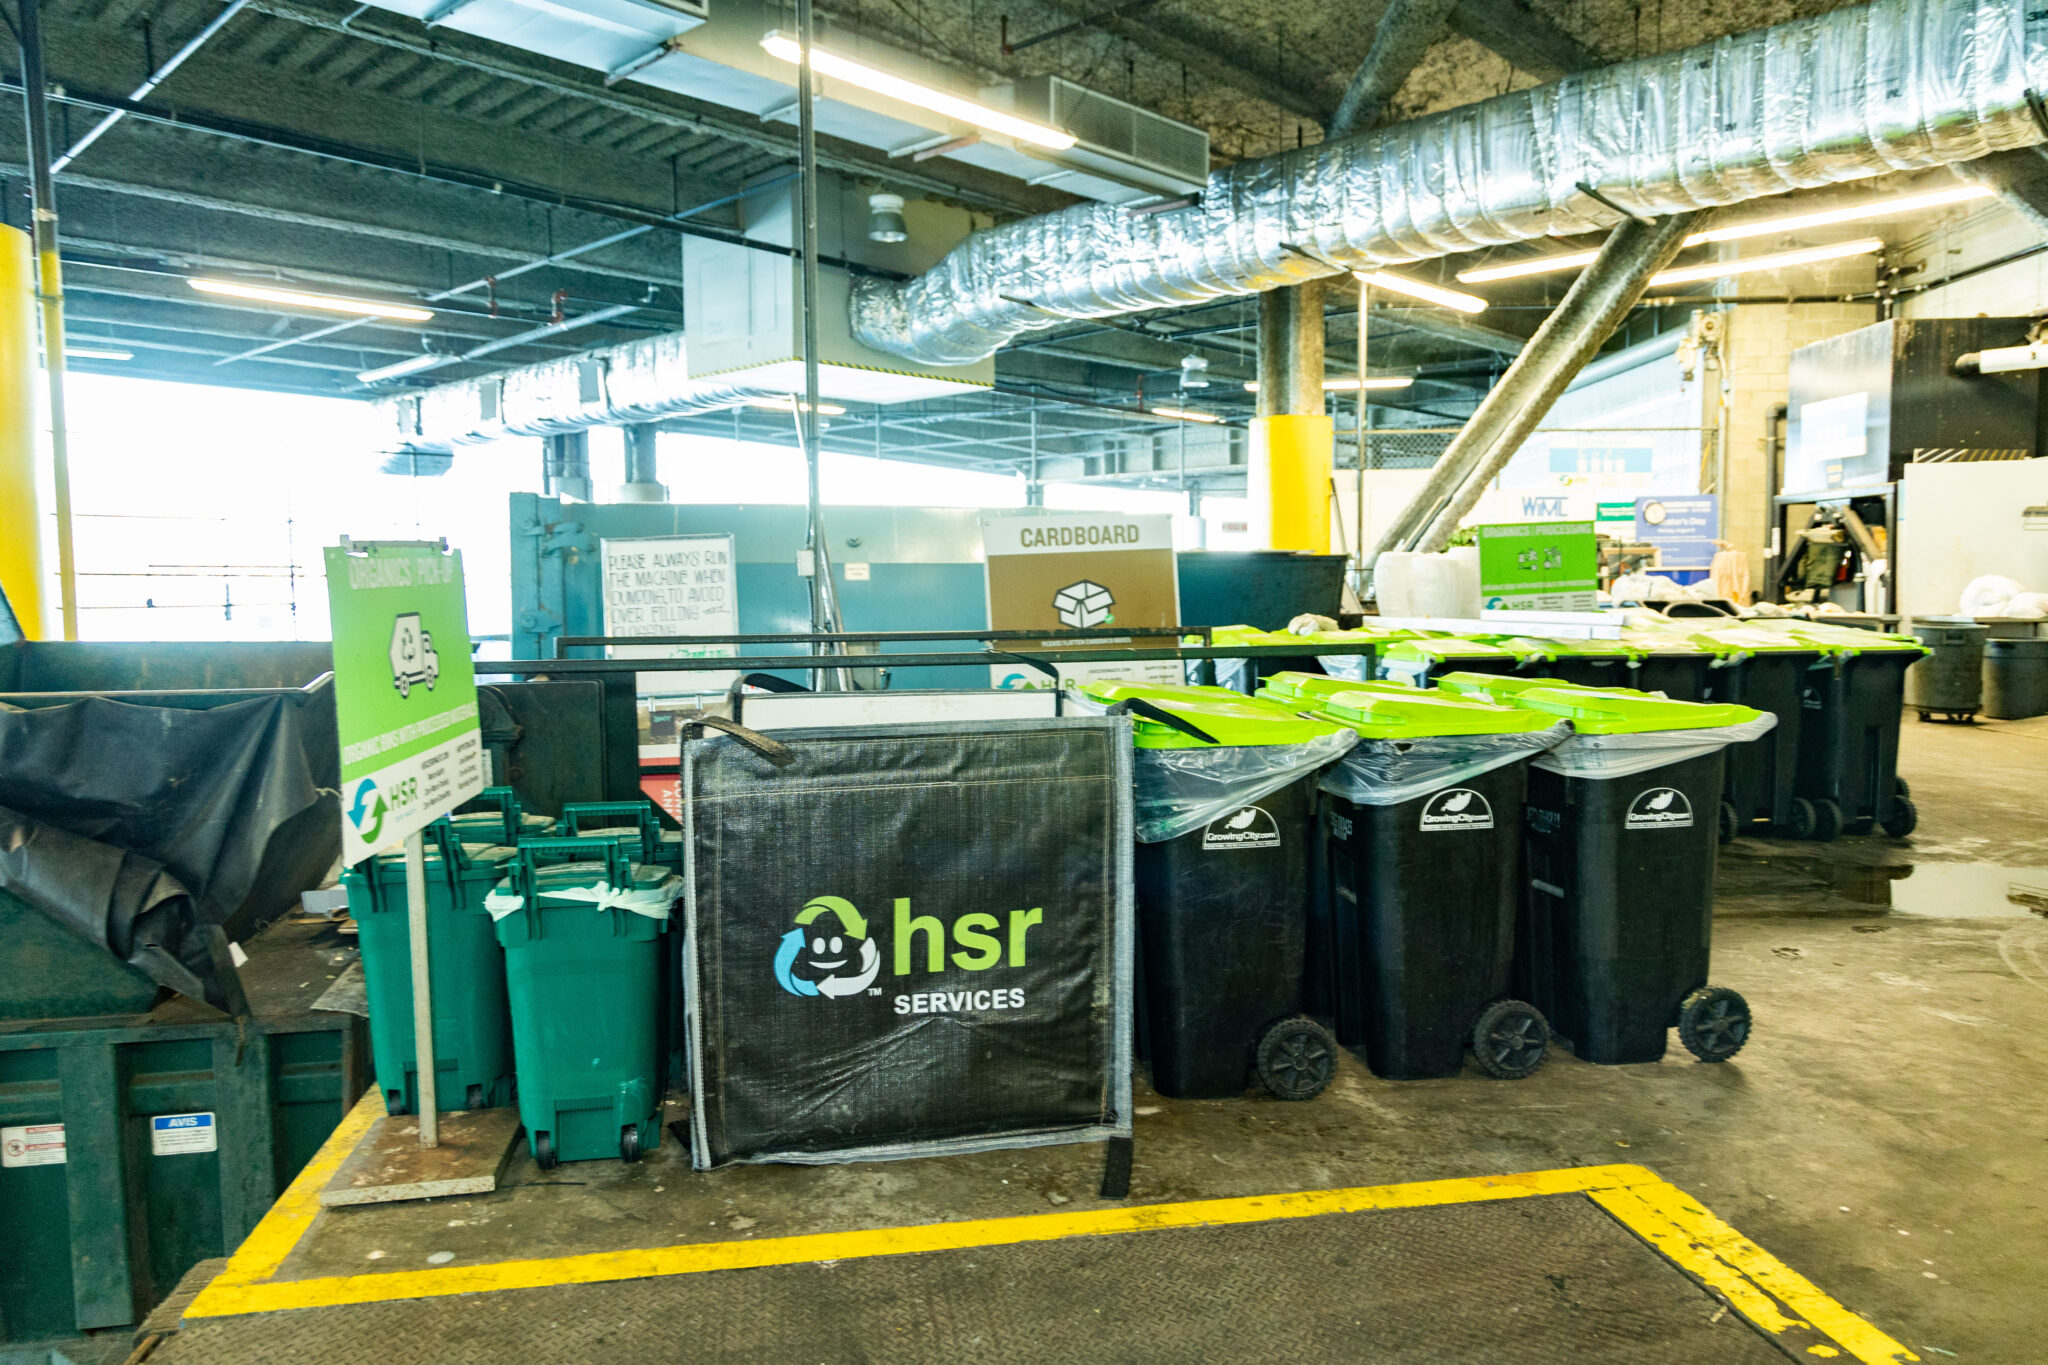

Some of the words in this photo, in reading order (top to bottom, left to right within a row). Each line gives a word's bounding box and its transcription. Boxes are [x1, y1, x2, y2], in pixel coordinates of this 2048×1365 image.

[1020, 524, 1140, 548] CARDBOARD
[1483, 526, 1530, 538] ORGANICS
[1536, 523, 1592, 536] PROCESSING
[607, 553, 645, 571] PLEASE
[653, 551, 700, 568] ALWAYS
[350, 558, 412, 590] ORGANICS
[416, 557, 453, 585] PICK-UP
[608, 571, 630, 588] THE
[634, 570, 688, 586] MACHINE
[695, 568, 726, 584] WHEN
[687, 586, 725, 603] AVOID
[611, 607, 645, 624] OVER
[651, 605, 700, 623] FILLING
[1041, 679, 1076, 691] HR
[344, 735, 377, 766] ORGANIC
[389, 777, 418, 812] HSR
[1425, 813, 1490, 824] GrowingCity.com
[1629, 811, 1691, 822] GrowingCity.com
[1207, 831, 1276, 842] GrowingCity.com
[894, 897, 1043, 976] hsr
[893, 987, 1026, 1015] SERVICES
[168, 1116, 198, 1128] AVIS
